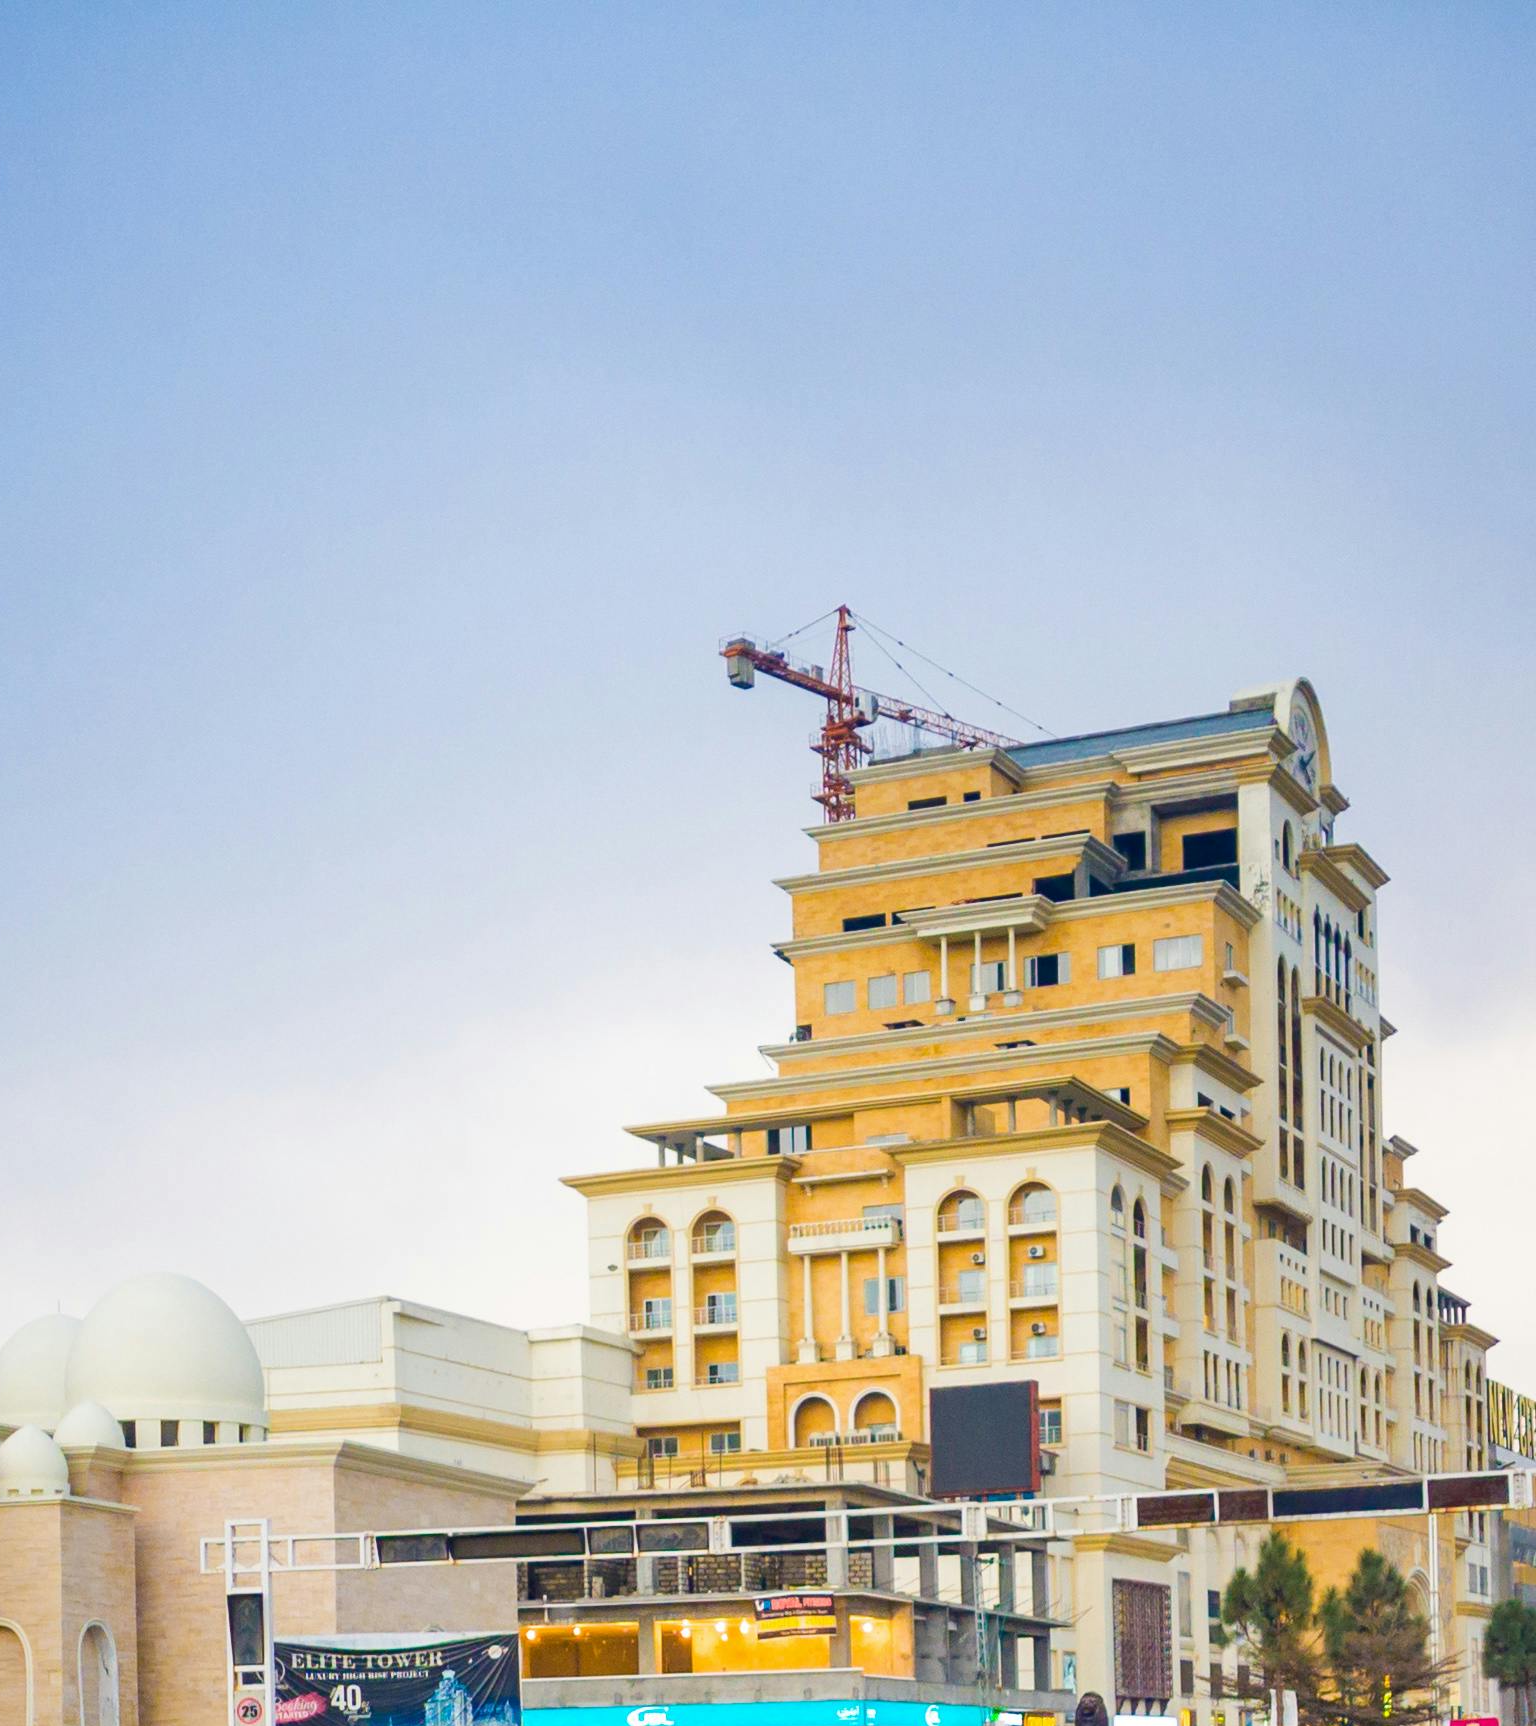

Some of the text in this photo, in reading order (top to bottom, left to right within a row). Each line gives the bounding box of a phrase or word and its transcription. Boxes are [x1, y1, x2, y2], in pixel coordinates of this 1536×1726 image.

[1485, 1378, 1513, 1453] NEW
[292, 1650, 444, 1669] ELITE TOWER
[305, 1672, 339, 1680] LUXURY
[342, 1672, 365, 1680] HIGH
[390, 1669, 429, 1679] PROJECT
[242, 1705, 258, 1718] 25
